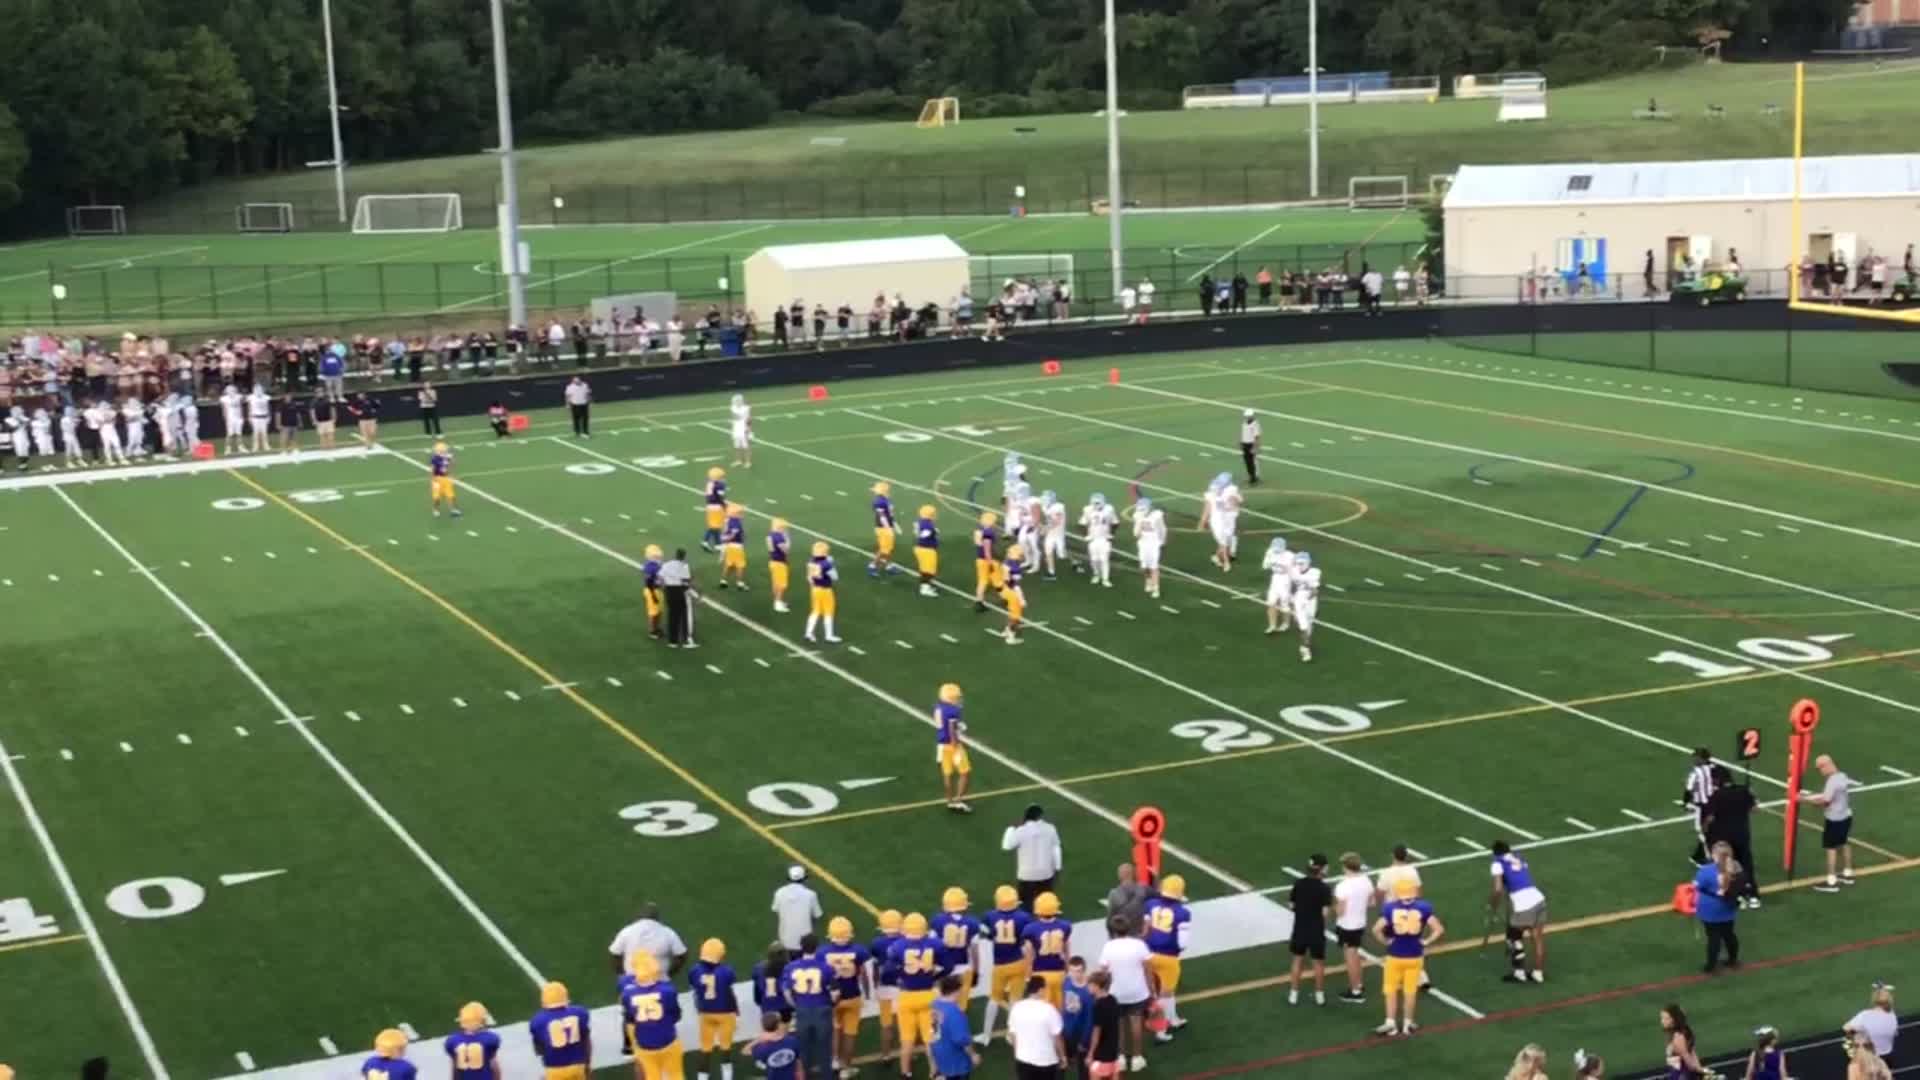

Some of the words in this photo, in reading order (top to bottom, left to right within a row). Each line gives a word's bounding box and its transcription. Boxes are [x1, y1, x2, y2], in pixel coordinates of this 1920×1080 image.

[1648, 637, 1833, 677] 10
[1170, 703, 1372, 753] 20
[1744, 730, 1759, 756] 2
[618, 782, 840, 837] 30
[995, 919, 1017, 944] 11
[904, 949, 934, 975] 54
[632, 993, 663, 1021] 75
